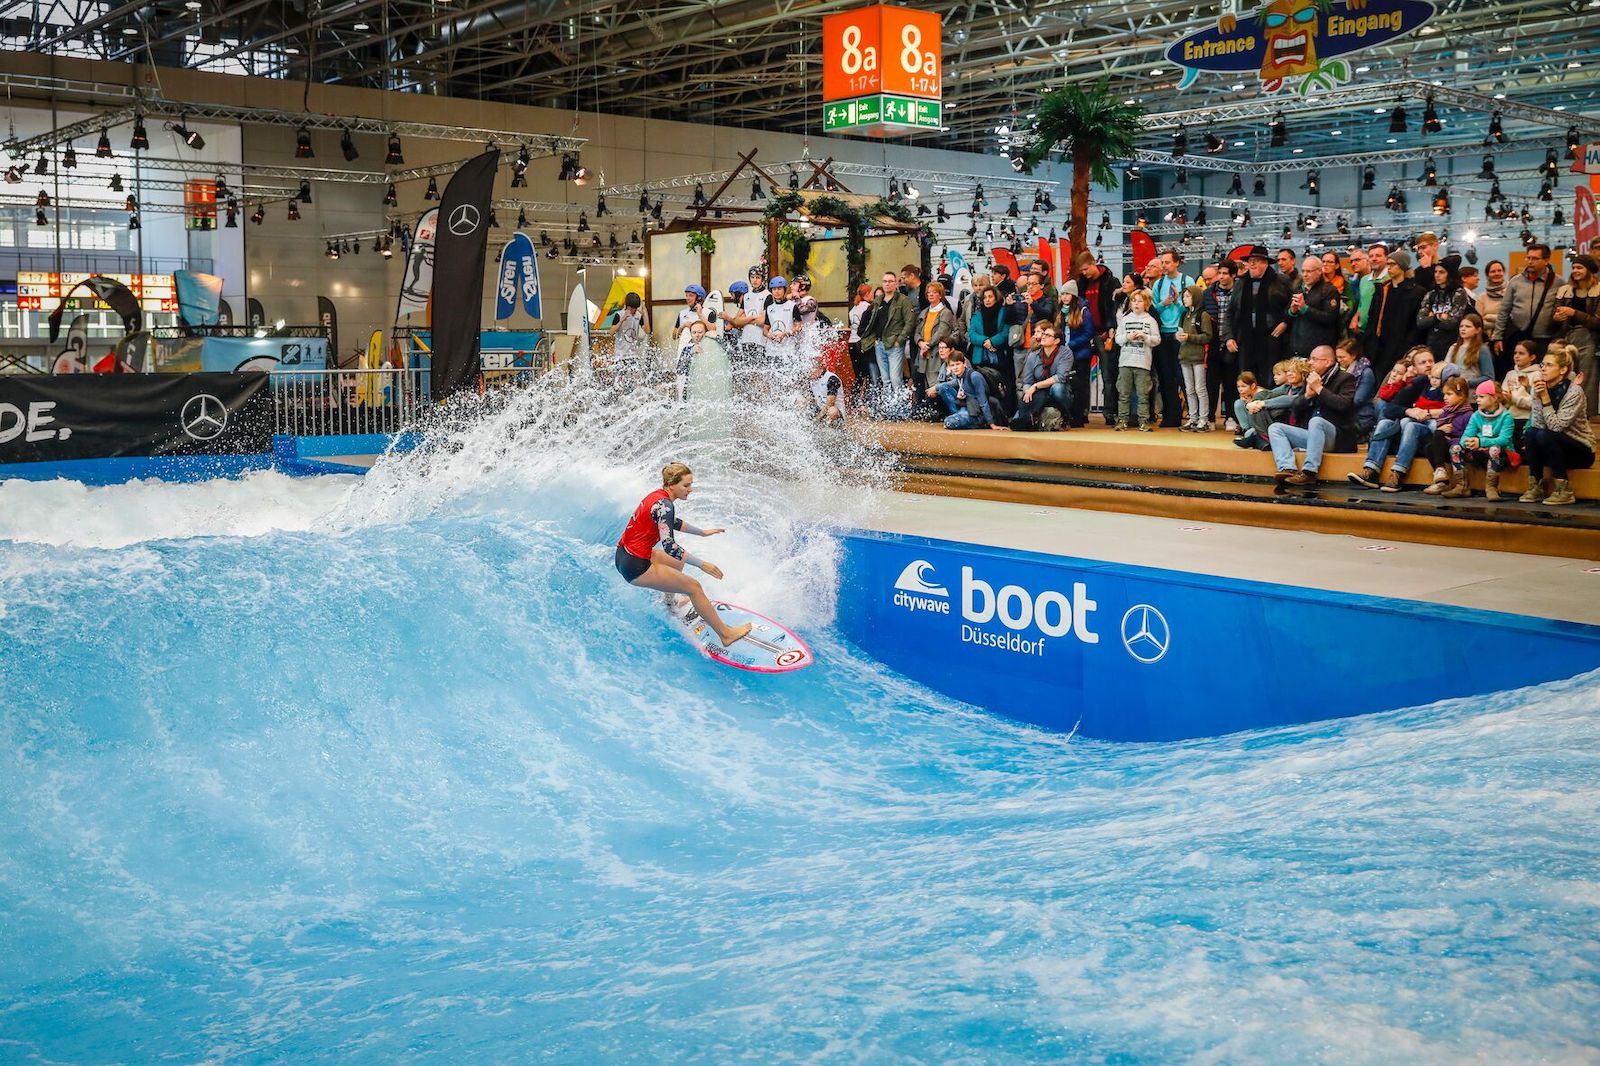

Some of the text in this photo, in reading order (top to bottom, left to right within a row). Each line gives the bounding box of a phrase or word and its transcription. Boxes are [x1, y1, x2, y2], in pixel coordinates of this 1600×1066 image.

[1327, 10, 1403, 38] Eingang
[841, 25, 877, 75] 8a
[900, 24, 937, 76] 8a
[1184, 35, 1256, 61] Entrance
[849, 75, 868, 91] 1-17
[910, 77, 929, 92] 1-17
[859, 103, 869, 111] Exit
[859, 112, 879, 121] Ausgang
[918, 105, 928, 113] Exit
[918, 115, 939, 125] Ausgang
[501, 260, 517, 304] Siren
[893, 592, 950, 615] citywave
[961, 565, 1099, 644] boot
[961, 624, 1045, 657] Düsseldorf
